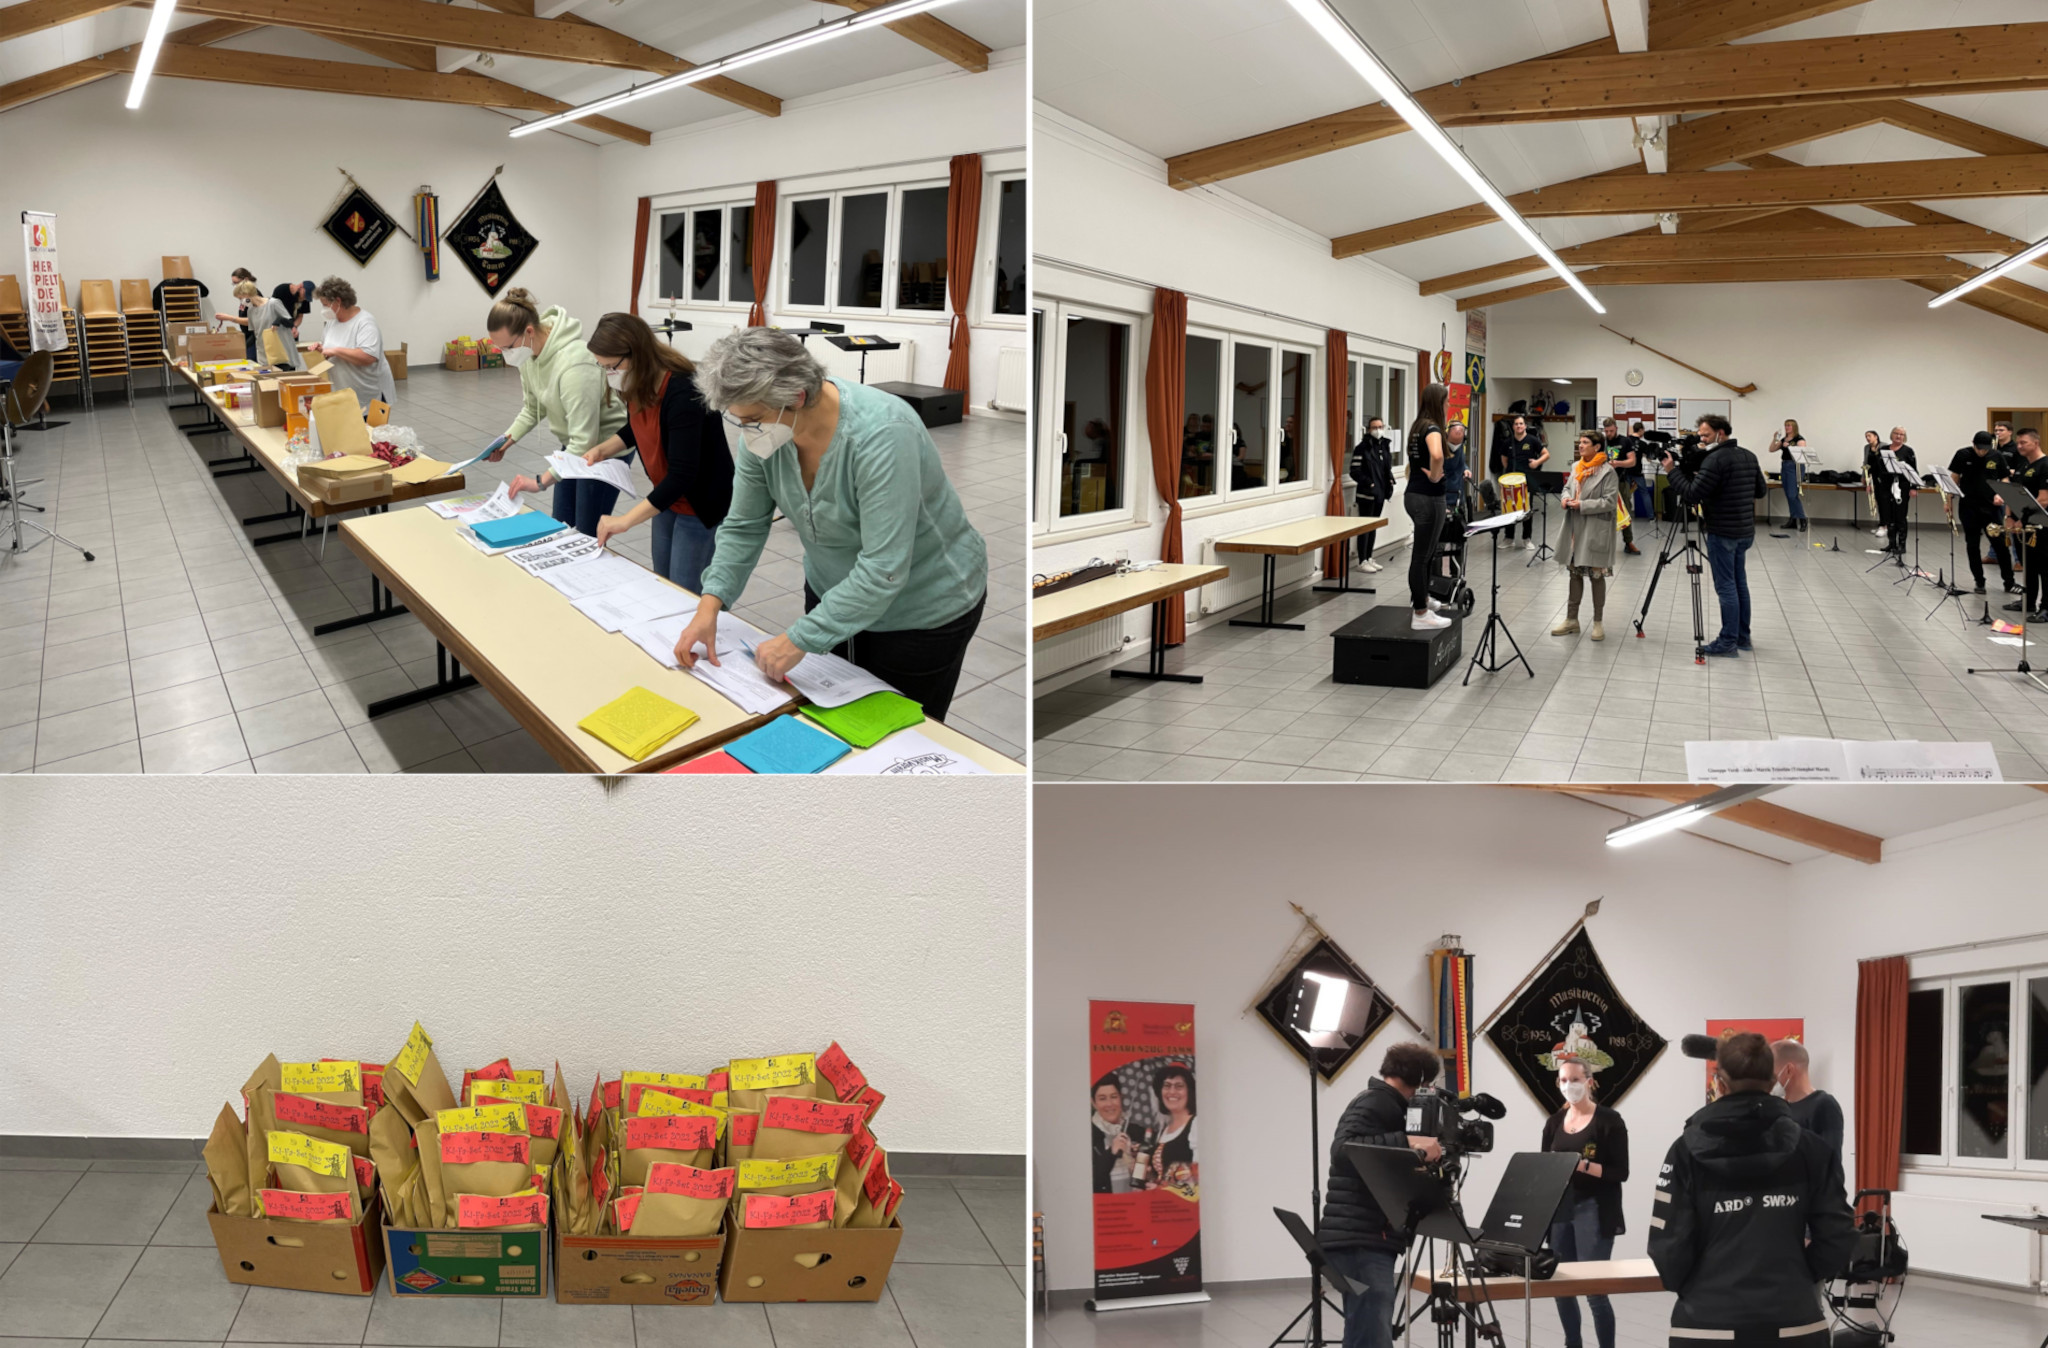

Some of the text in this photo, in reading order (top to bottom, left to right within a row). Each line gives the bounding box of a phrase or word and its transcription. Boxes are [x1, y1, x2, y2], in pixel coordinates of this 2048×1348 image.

[37, 288, 54, 300] DIE
[1549, 987, 1608, 1014] Musikverein
[1530, 1030, 1552, 1042] 1954
[773, 1069, 792, 1079] 2022
[480, 1119, 499, 1129] 2022
[812, 1118, 834, 1128] 2022
[670, 1132, 690, 1141] 2022
[1714, 1195, 1786, 1213] ARD SWR
[503, 1209, 522, 1217] 2022
[792, 1209, 811, 1217] 2022
[520, 1285, 536, 1293] Fair
